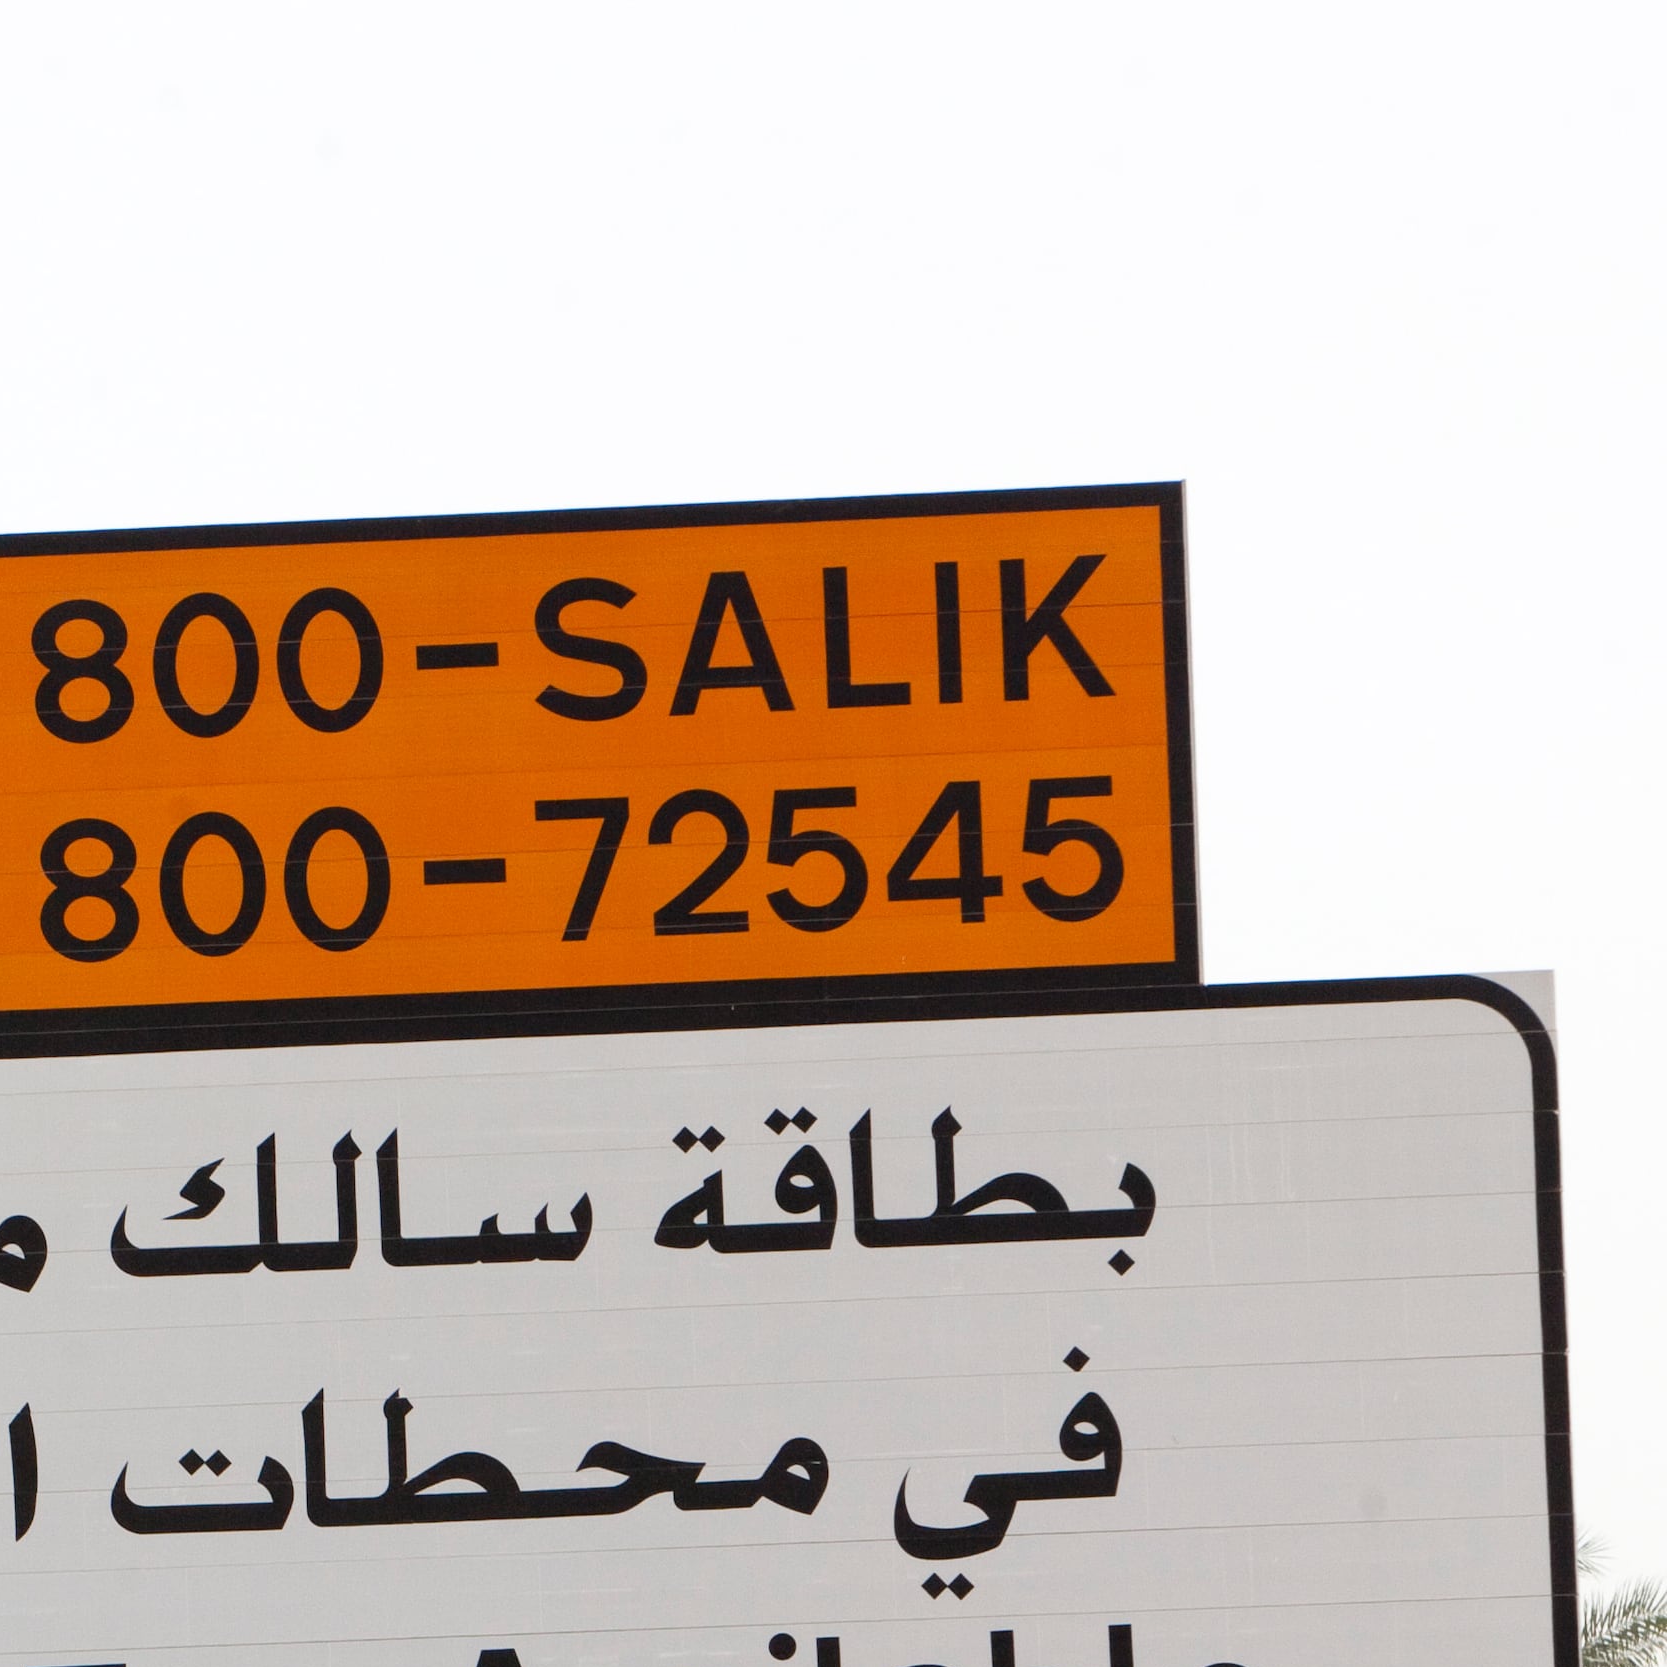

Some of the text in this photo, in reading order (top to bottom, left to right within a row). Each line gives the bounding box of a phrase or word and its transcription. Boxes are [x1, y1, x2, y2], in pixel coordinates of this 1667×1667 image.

[29, 553, 1115, 744] 800-SALIK
[37, 774, 1126, 964] 800-72545
[110, 1128, 593, 1278] سالك
[653, 1106, 1156, 1276] بطاقة
[110, 1387, 830, 1535] محطات
[893, 1346, 1123, 1600] في
